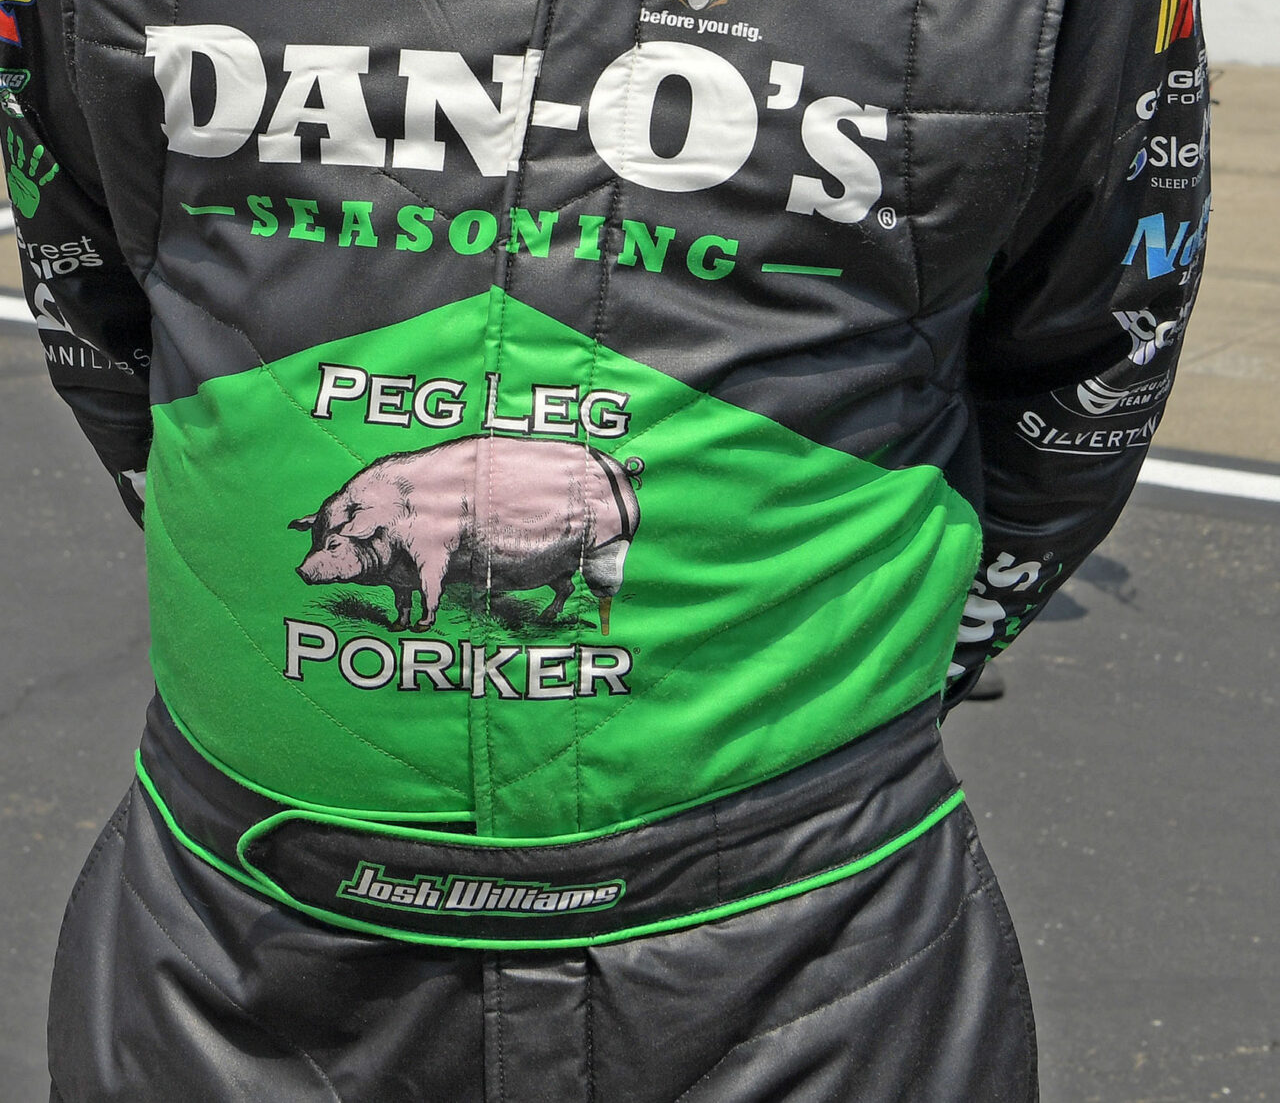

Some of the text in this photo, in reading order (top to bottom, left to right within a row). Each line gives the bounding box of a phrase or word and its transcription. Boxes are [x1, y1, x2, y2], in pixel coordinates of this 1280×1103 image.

[640, 8, 762, 42] before you dig.
[145, 24, 888, 224] DAN-O'S
[1150, 176, 1188, 189] SLEEP
[249, 194, 740, 281] SEASONING
[311, 363, 631, 439] PEG LEG
[348, 869, 619, 911] Josh Williams
